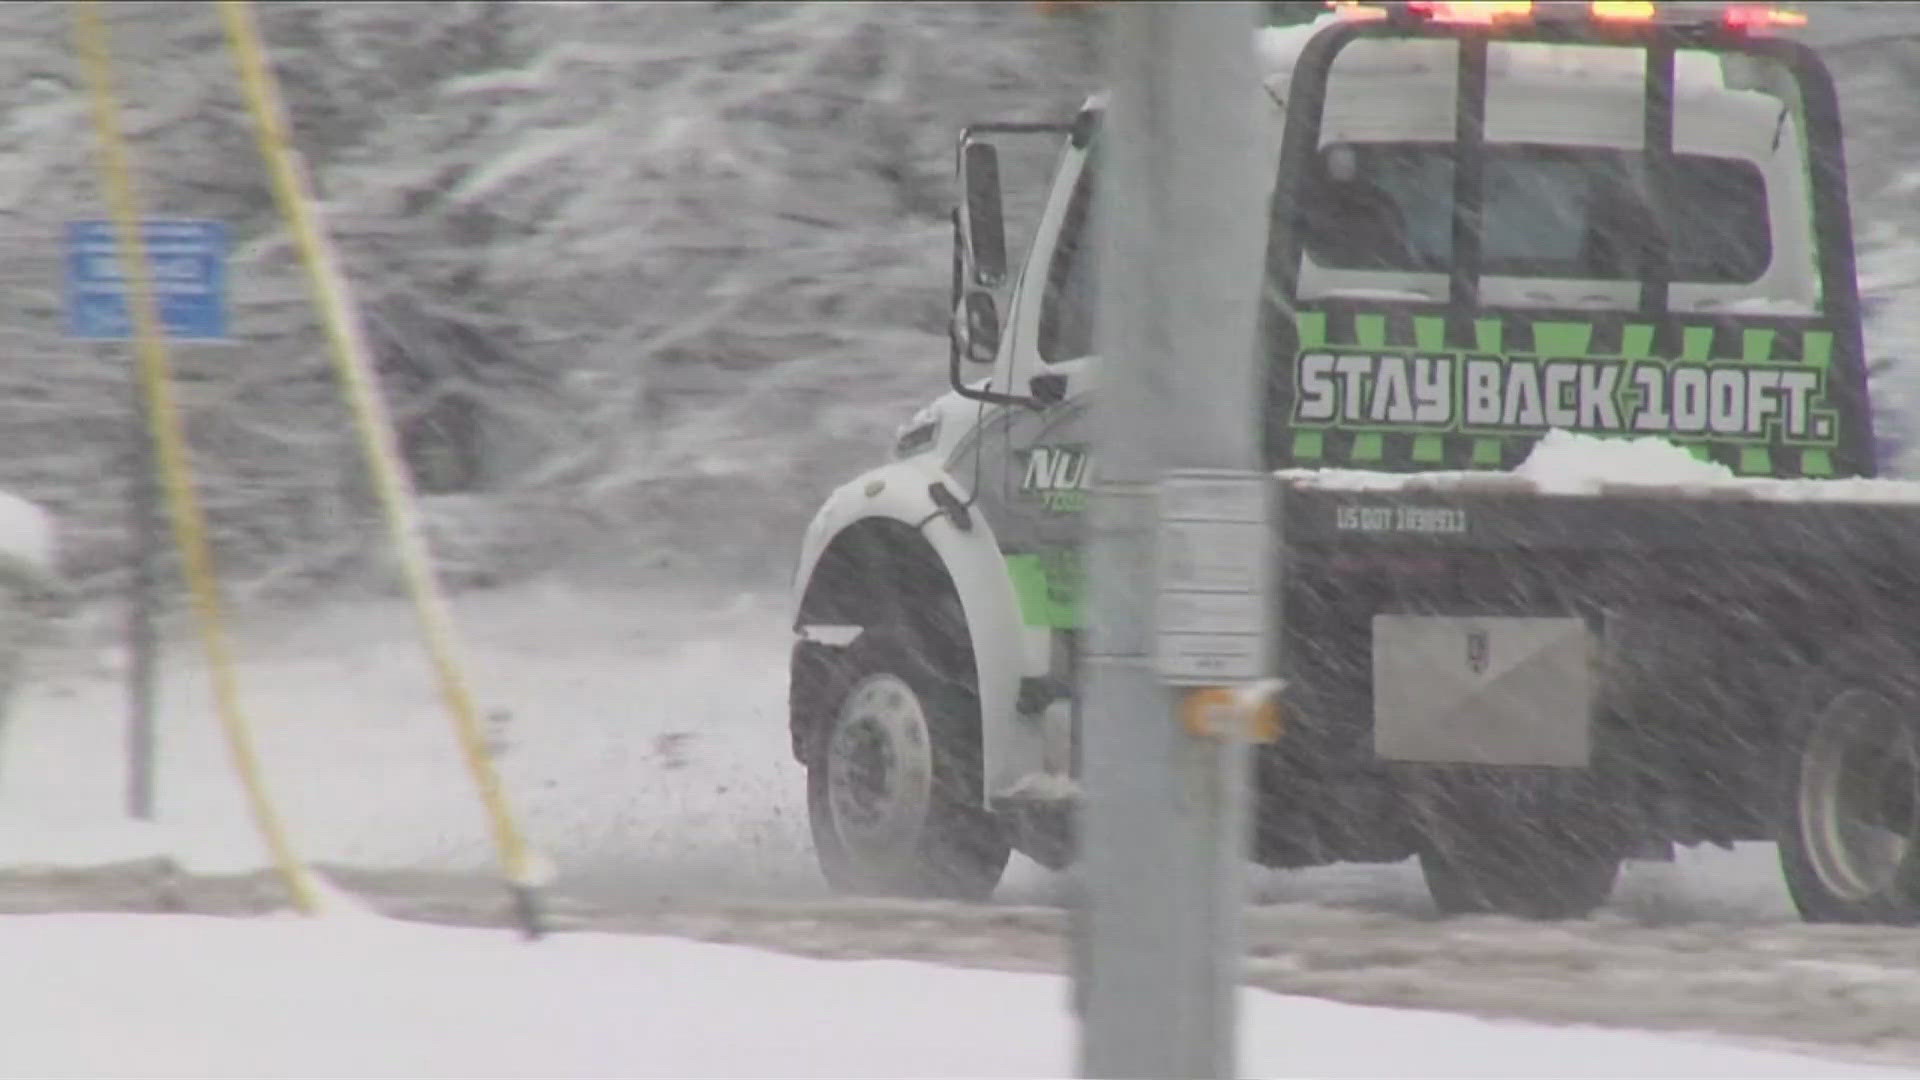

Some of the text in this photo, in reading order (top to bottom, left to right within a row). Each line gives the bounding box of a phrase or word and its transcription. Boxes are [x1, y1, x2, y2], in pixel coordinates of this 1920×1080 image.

[1299, 353, 1830, 437] STAY BACK 100FT.
[1336, 506, 1359, 529] US
